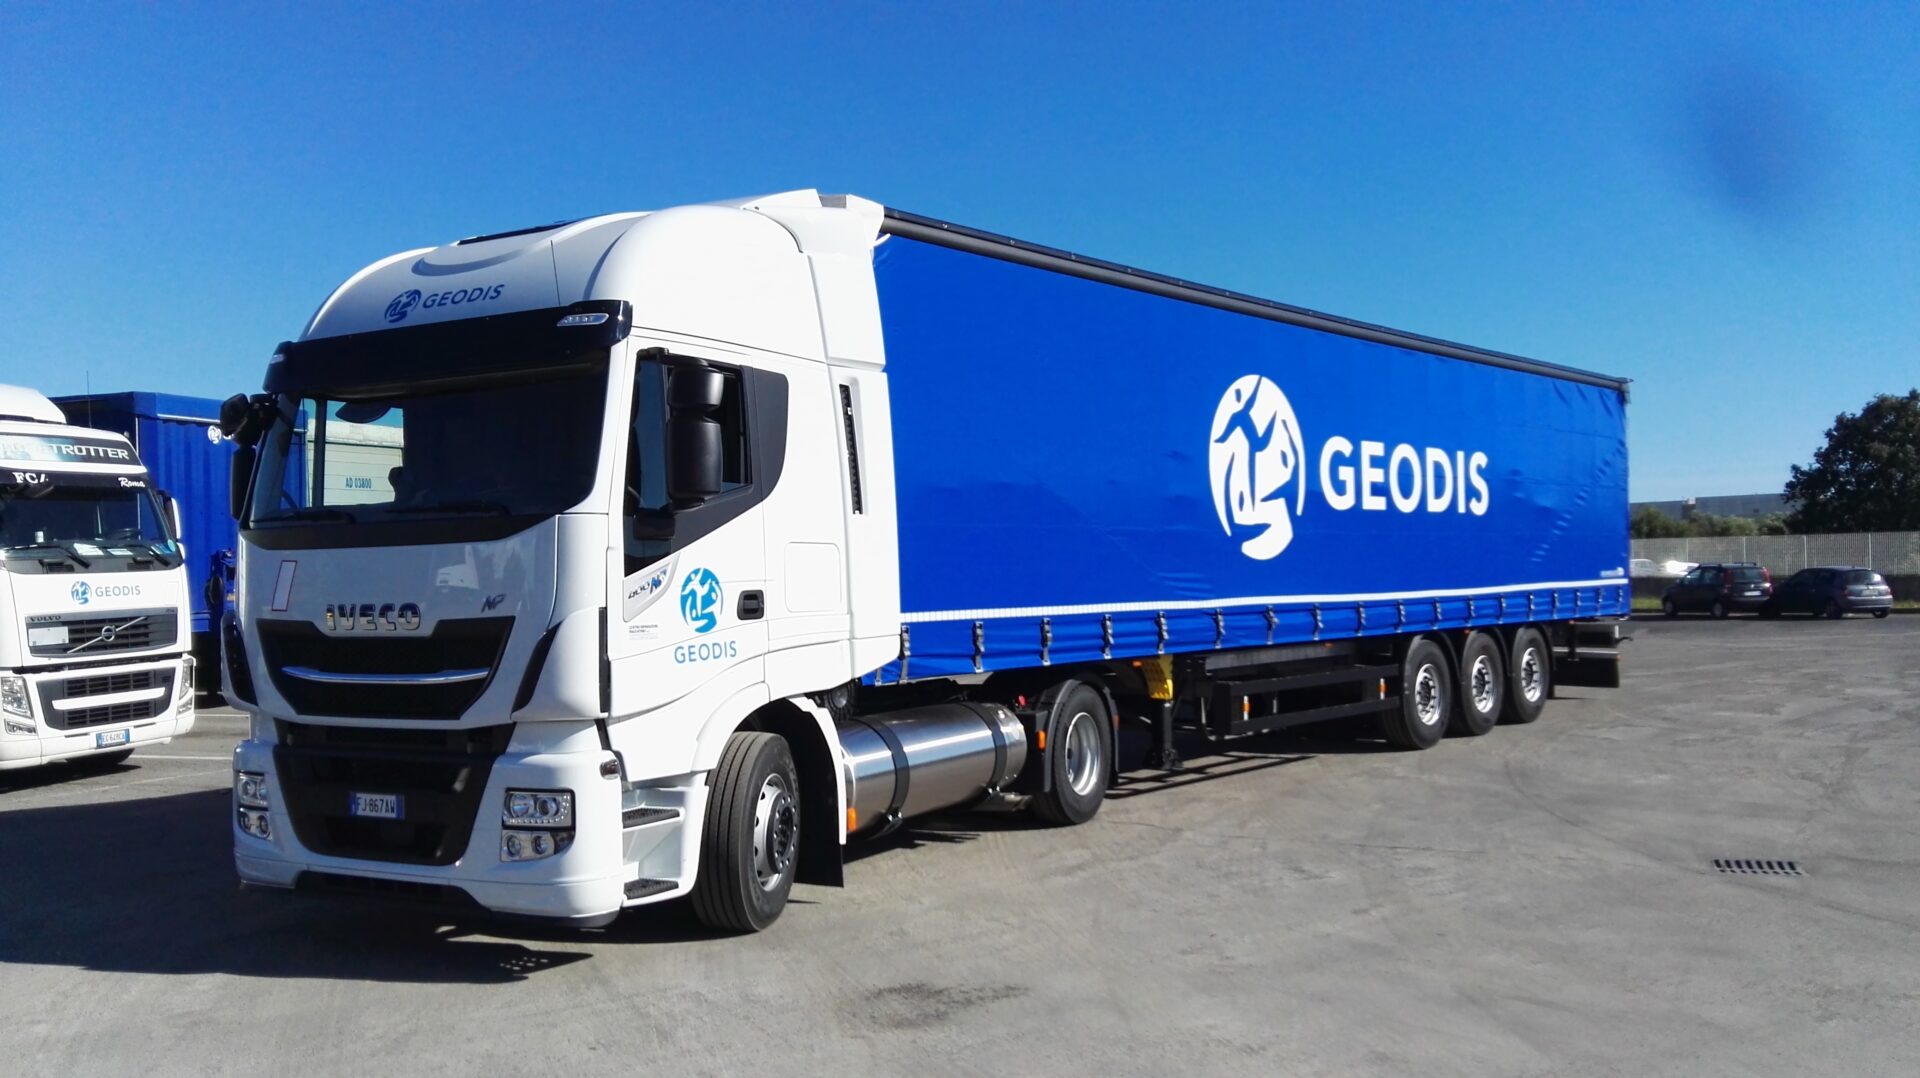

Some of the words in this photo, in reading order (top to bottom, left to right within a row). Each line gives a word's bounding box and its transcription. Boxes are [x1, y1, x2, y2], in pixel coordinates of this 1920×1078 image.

[422, 284, 505, 309] GEODIS
[118, 477, 146, 488] Roma
[345, 477, 353, 489] AD
[1319, 435, 1489, 516] GEODIS
[95, 584, 141, 598] GEODIS
[325, 602, 422, 631] IVECO
[674, 640, 737, 664] GEODIS
